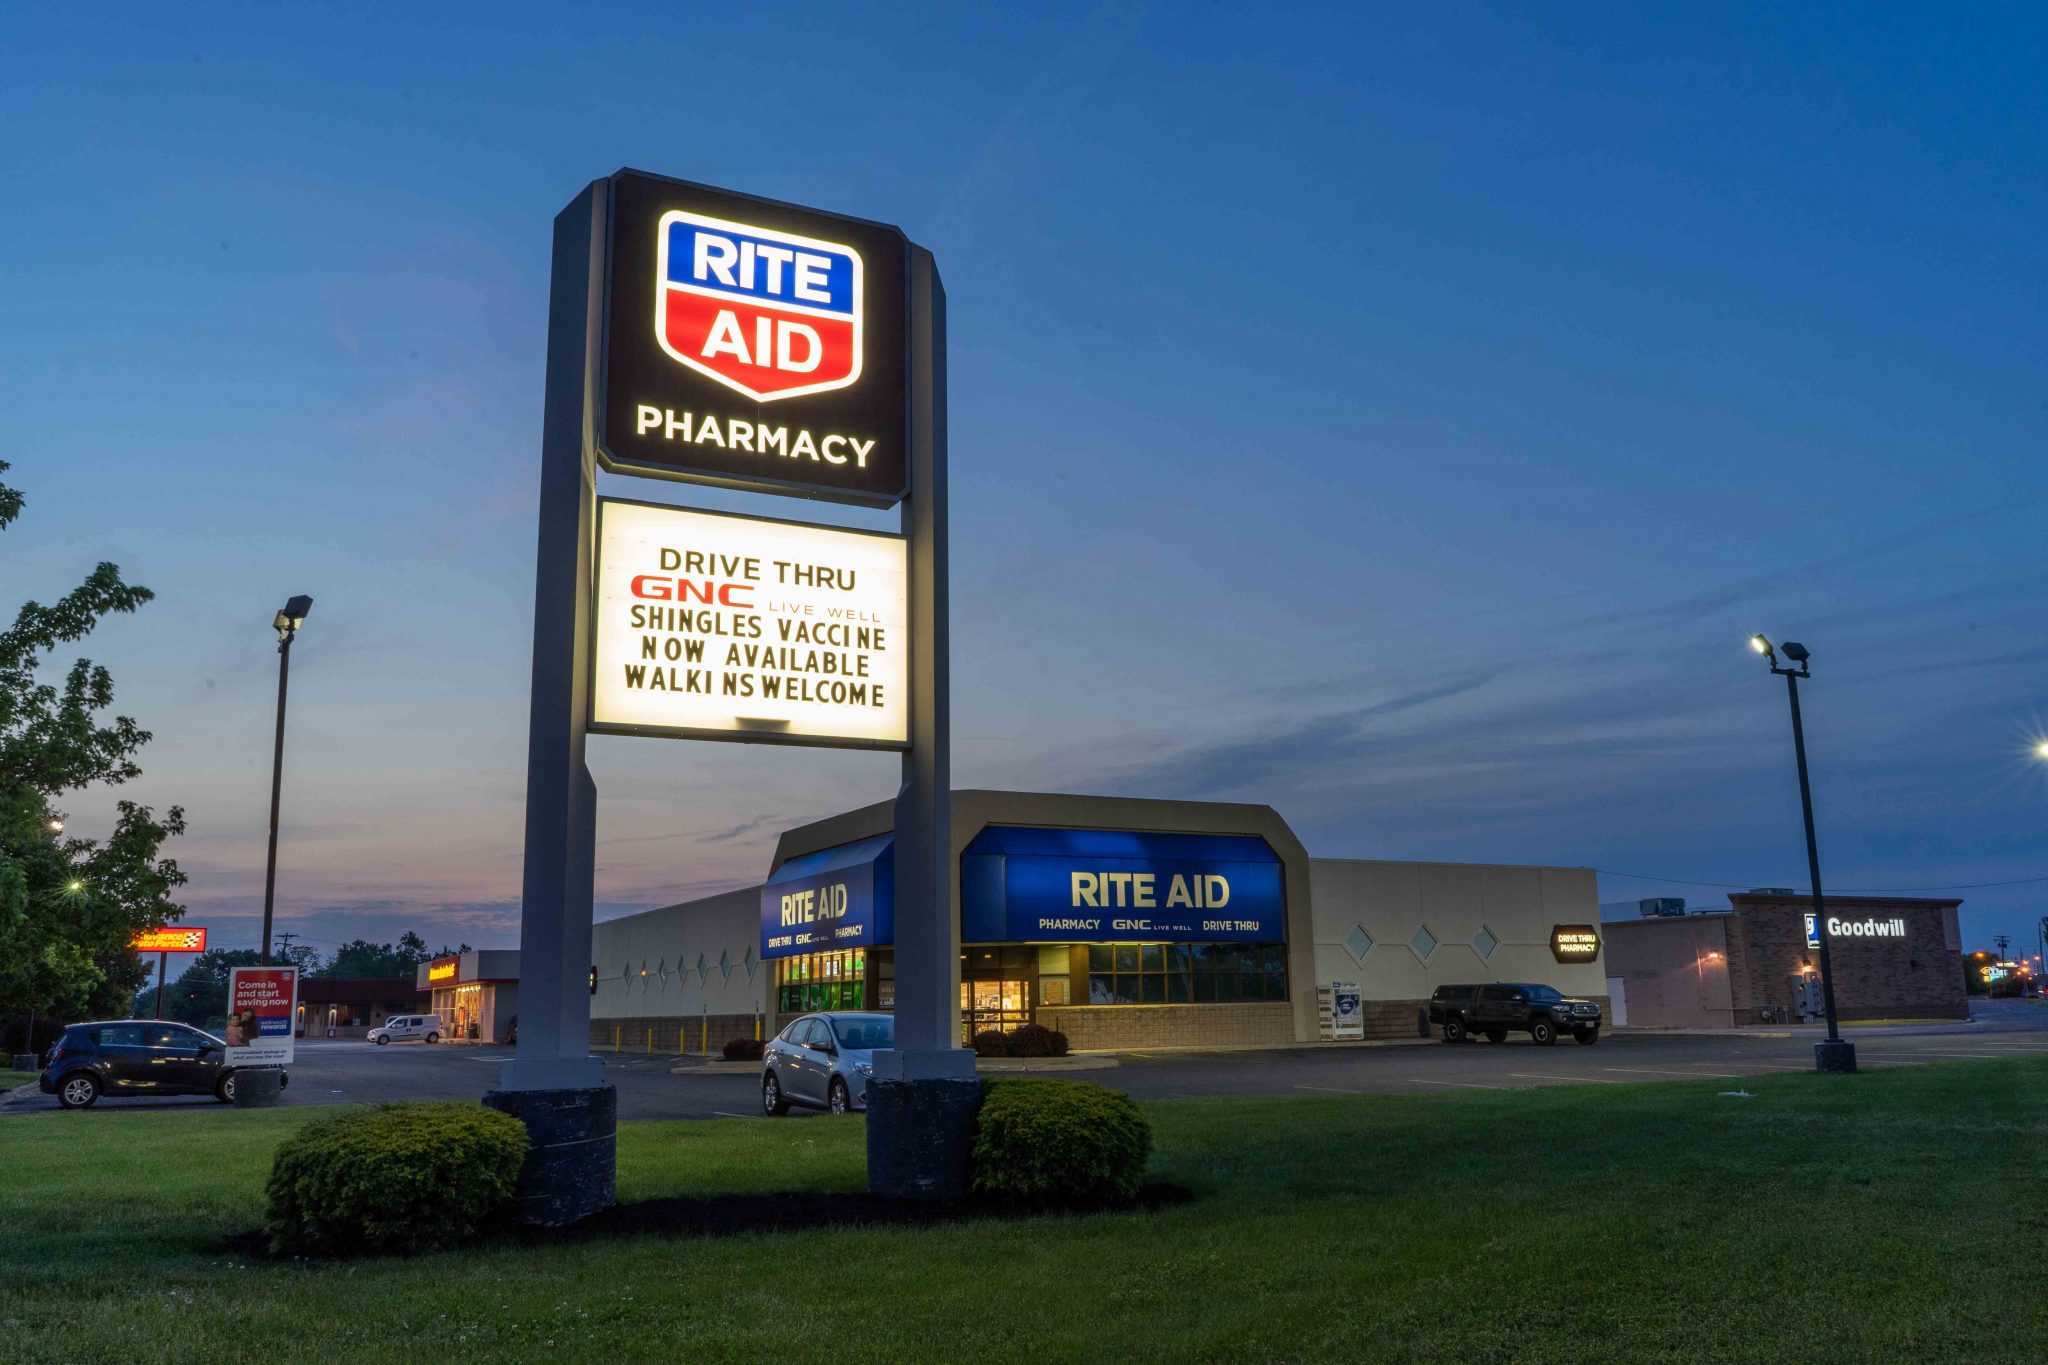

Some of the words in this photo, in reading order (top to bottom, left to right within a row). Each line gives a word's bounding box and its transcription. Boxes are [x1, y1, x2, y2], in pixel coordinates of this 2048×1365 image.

[693, 231, 832, 304] RITE
[701, 309, 823, 373] AID
[636, 404, 876, 468] PHARMACY
[660, 547, 761, 581] DRIVE
[773, 560, 856, 592] THRU
[630, 574, 755, 609] GNC
[769, 601, 814, 616] LIVE
[827, 608, 881, 623] WELL
[630, 604, 762, 639] SHINGLES
[778, 618, 886, 651] VACCINE
[641, 635, 705, 663] NOW
[725, 642, 869, 678] AVAILABLE
[781, 889, 814, 927] RITE
[817, 883, 847, 920] AID
[1071, 871, 1156, 907] RITE
[1166, 874, 1230, 908] AID
[768, 937, 780, 948] DRIVE
[780, 936, 792, 946] THRU
[796, 933, 812, 945] GNC
[835, 924, 863, 939] PHARMACY
[1039, 918, 1100, 930] PHARMACY
[1112, 919, 1152, 930] GNC
[1203, 920, 1232, 931] DRIVE
[1233, 920, 1259, 931] THRU
[1558, 934, 1578, 943] DRIVE
[1578, 934, 1596, 943] THRU
[1827, 917, 1905, 936] Goodwill
[1560, 944, 1595, 952] PHARMACY
[237, 990, 256, 998] and
[257, 989, 280, 997] start
[237, 999, 268, 1007] saving
[238, 981, 268, 989] Come
[268, 981, 277, 989] in
